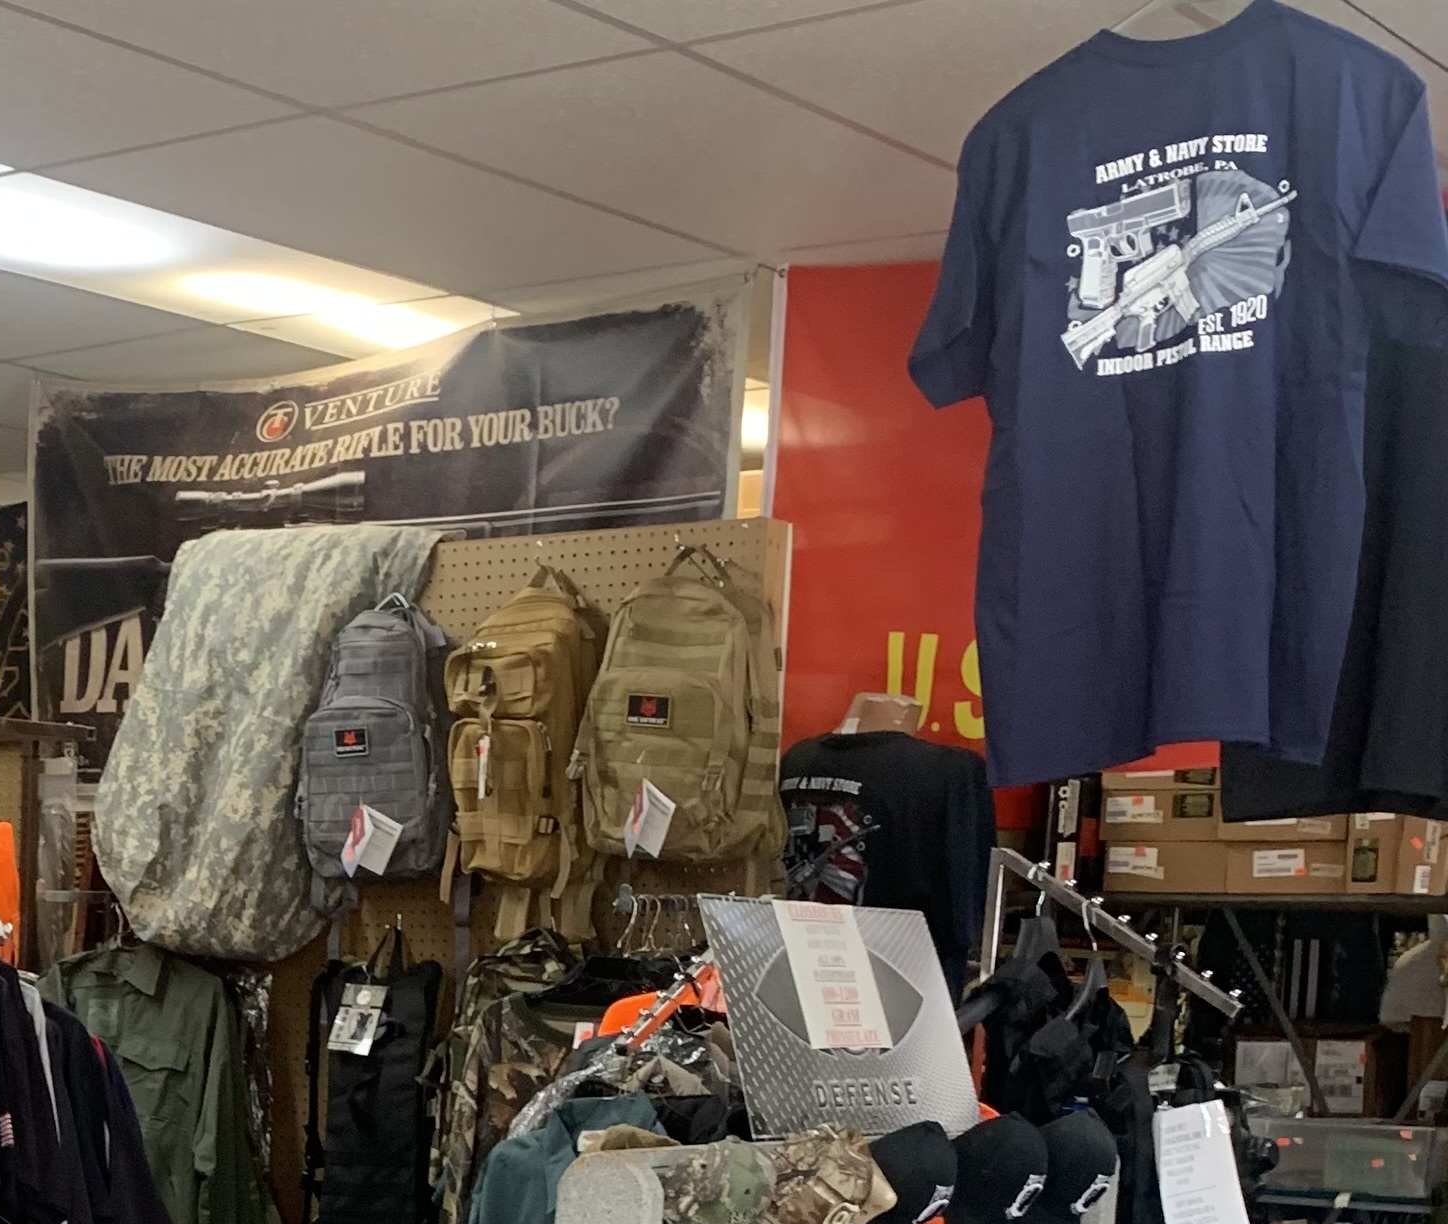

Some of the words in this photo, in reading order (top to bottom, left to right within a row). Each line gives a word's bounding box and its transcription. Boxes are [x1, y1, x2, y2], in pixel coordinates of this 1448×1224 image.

[1095, 153, 1145, 184] ARMY
[1149, 149, 1163, 167] &
[1165, 137, 1209, 164] NAVY
[1212, 134, 1269, 154] STORE
[1121, 161, 1209, 193] LATROBE,
[1214, 159, 1239, 171] PA
[1230, 294, 1268, 327] 1920
[1097, 352, 1154, 376] INDOOR
[1156, 338, 1197, 367] PISTOL
[1200, 330, 1254, 352] RANGE
[304, 371, 443, 430] VENTURE
[104, 454, 148, 486] THE
[146, 454, 219, 483] MOST
[213, 440, 334, 482] ACCURATE
[330, 421, 404, 464] RIFLE
[409, 416, 464, 454] FOR
[467, 407, 534, 449] YOUR
[537, 396, 621, 440] BUCK?
[814, 1079, 917, 1108] DEFENSE
